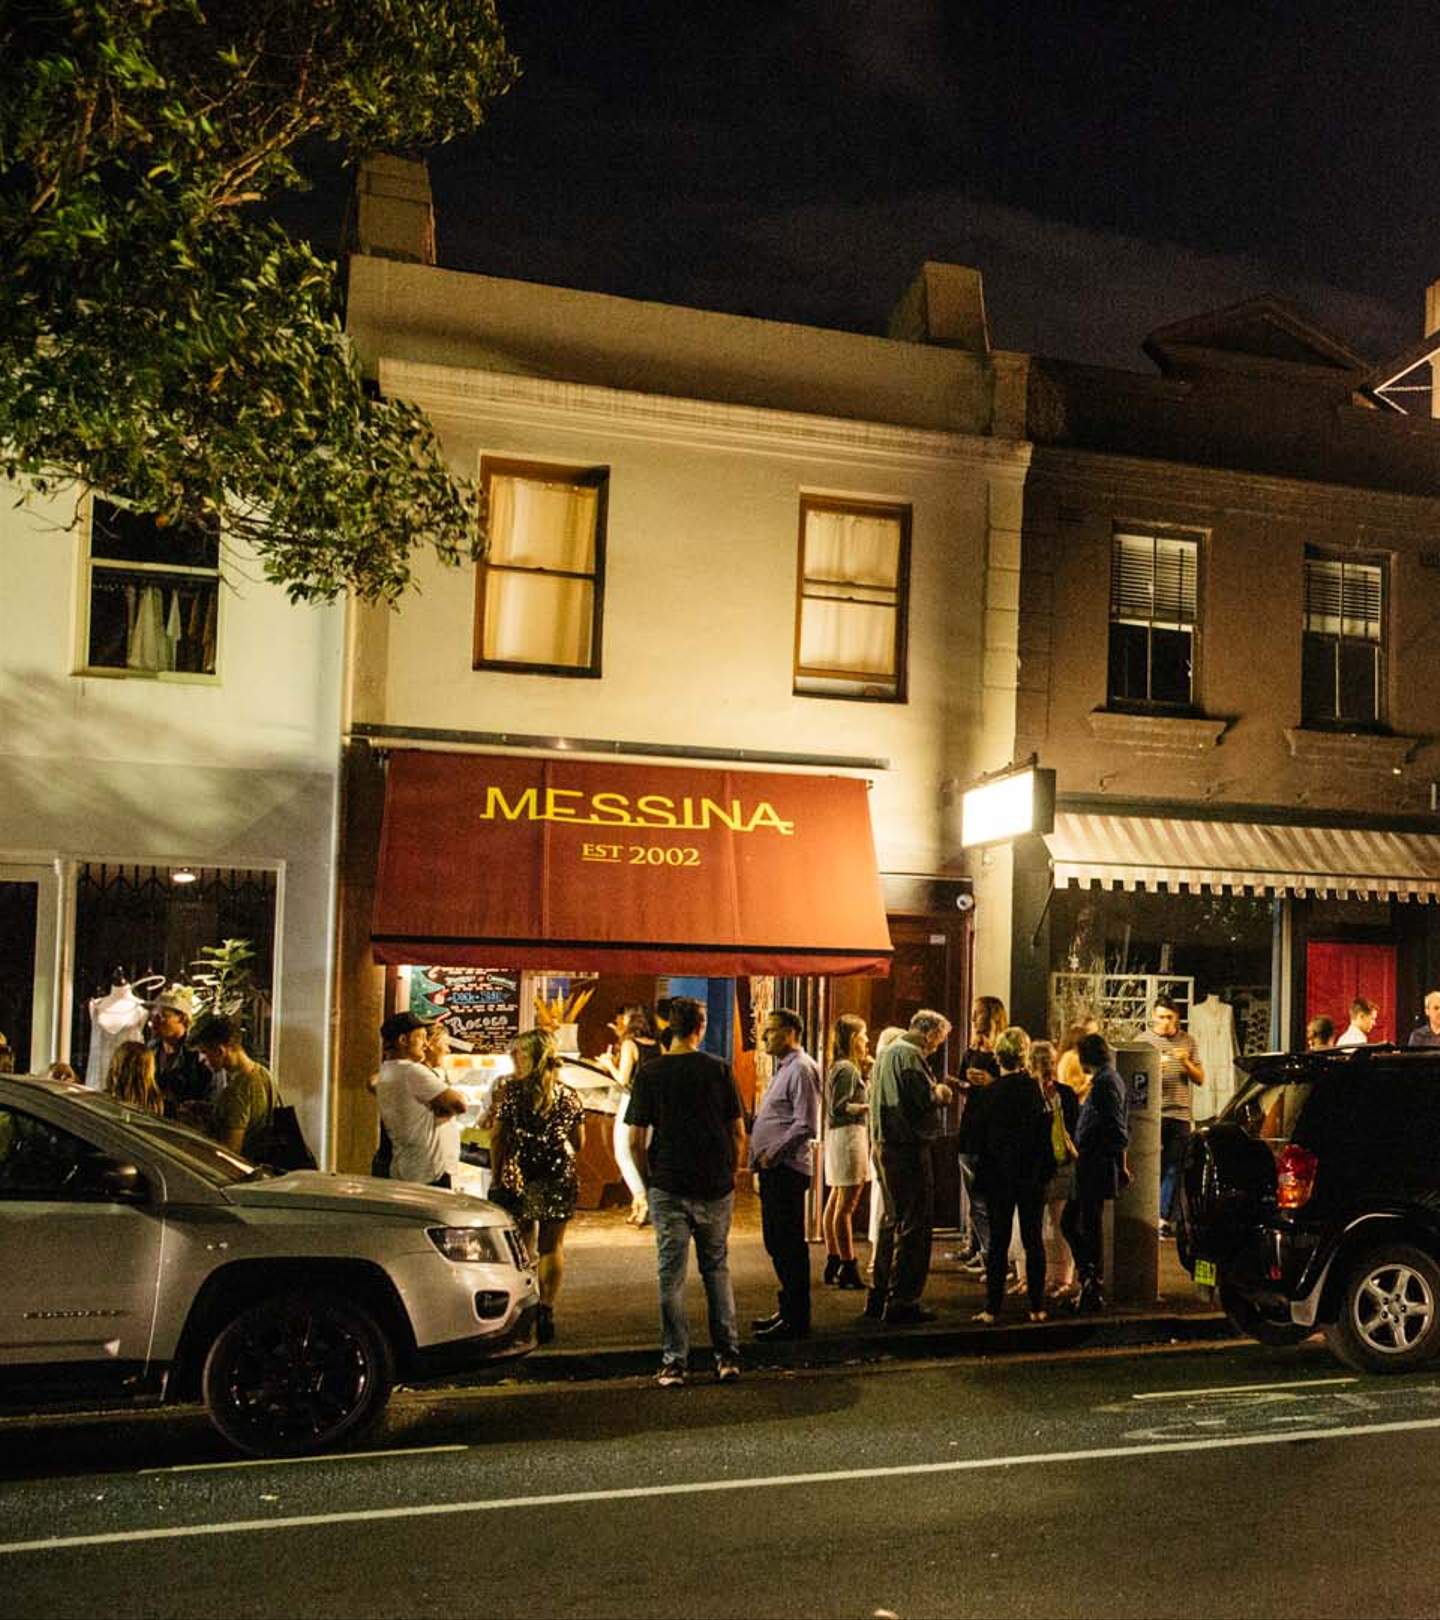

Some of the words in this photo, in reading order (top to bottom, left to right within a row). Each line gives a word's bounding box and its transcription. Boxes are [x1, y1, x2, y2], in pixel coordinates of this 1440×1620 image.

[480, 786, 794, 835] MESSINA
[582, 843, 624, 862] EST
[629, 845, 702, 867] 2002
[1134, 1074, 1146, 1089] P
